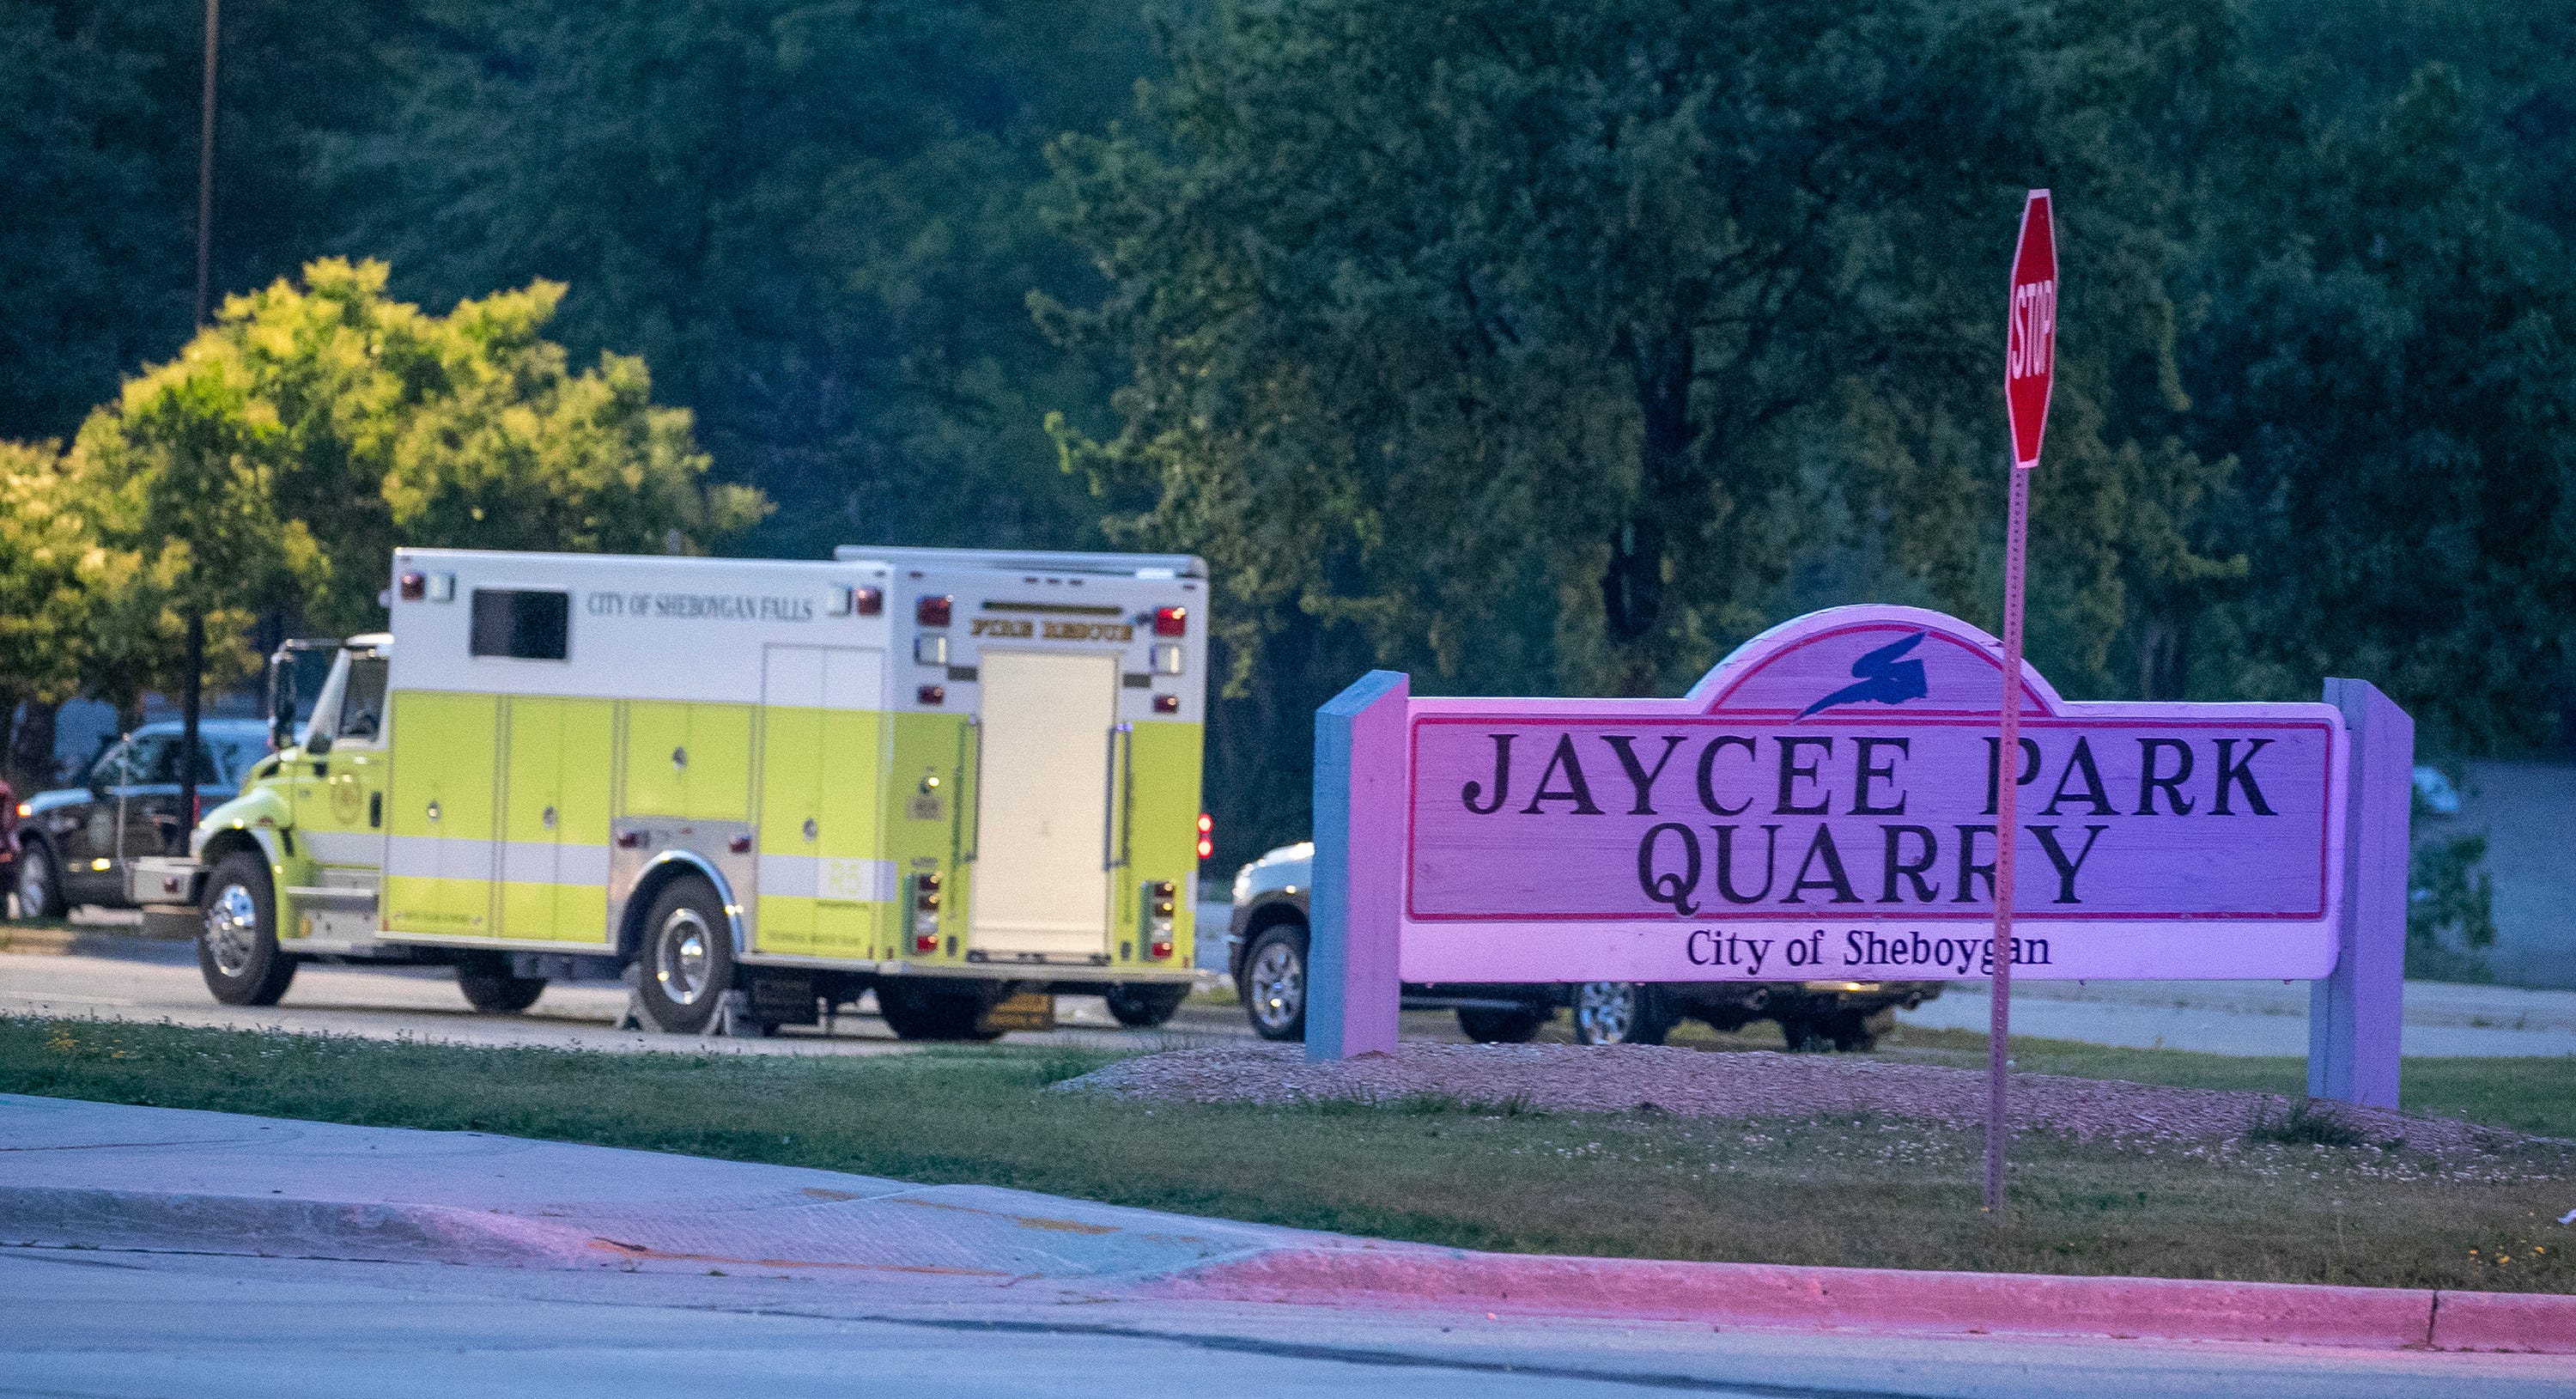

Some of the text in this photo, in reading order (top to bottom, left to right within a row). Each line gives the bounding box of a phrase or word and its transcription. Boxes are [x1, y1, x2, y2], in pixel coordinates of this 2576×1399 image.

[2012, 280, 2053, 380] STOP
[587, 592, 813, 622] CITY OF SHEBOYGAN FALLS
[971, 618, 1133, 642] FIRE RESCUE
[1461, 733, 2279, 817] JAYCEE PARK
[1637, 822, 2110, 916] QUARRY
[1686, 929, 2053, 976] City of Sheboygan
